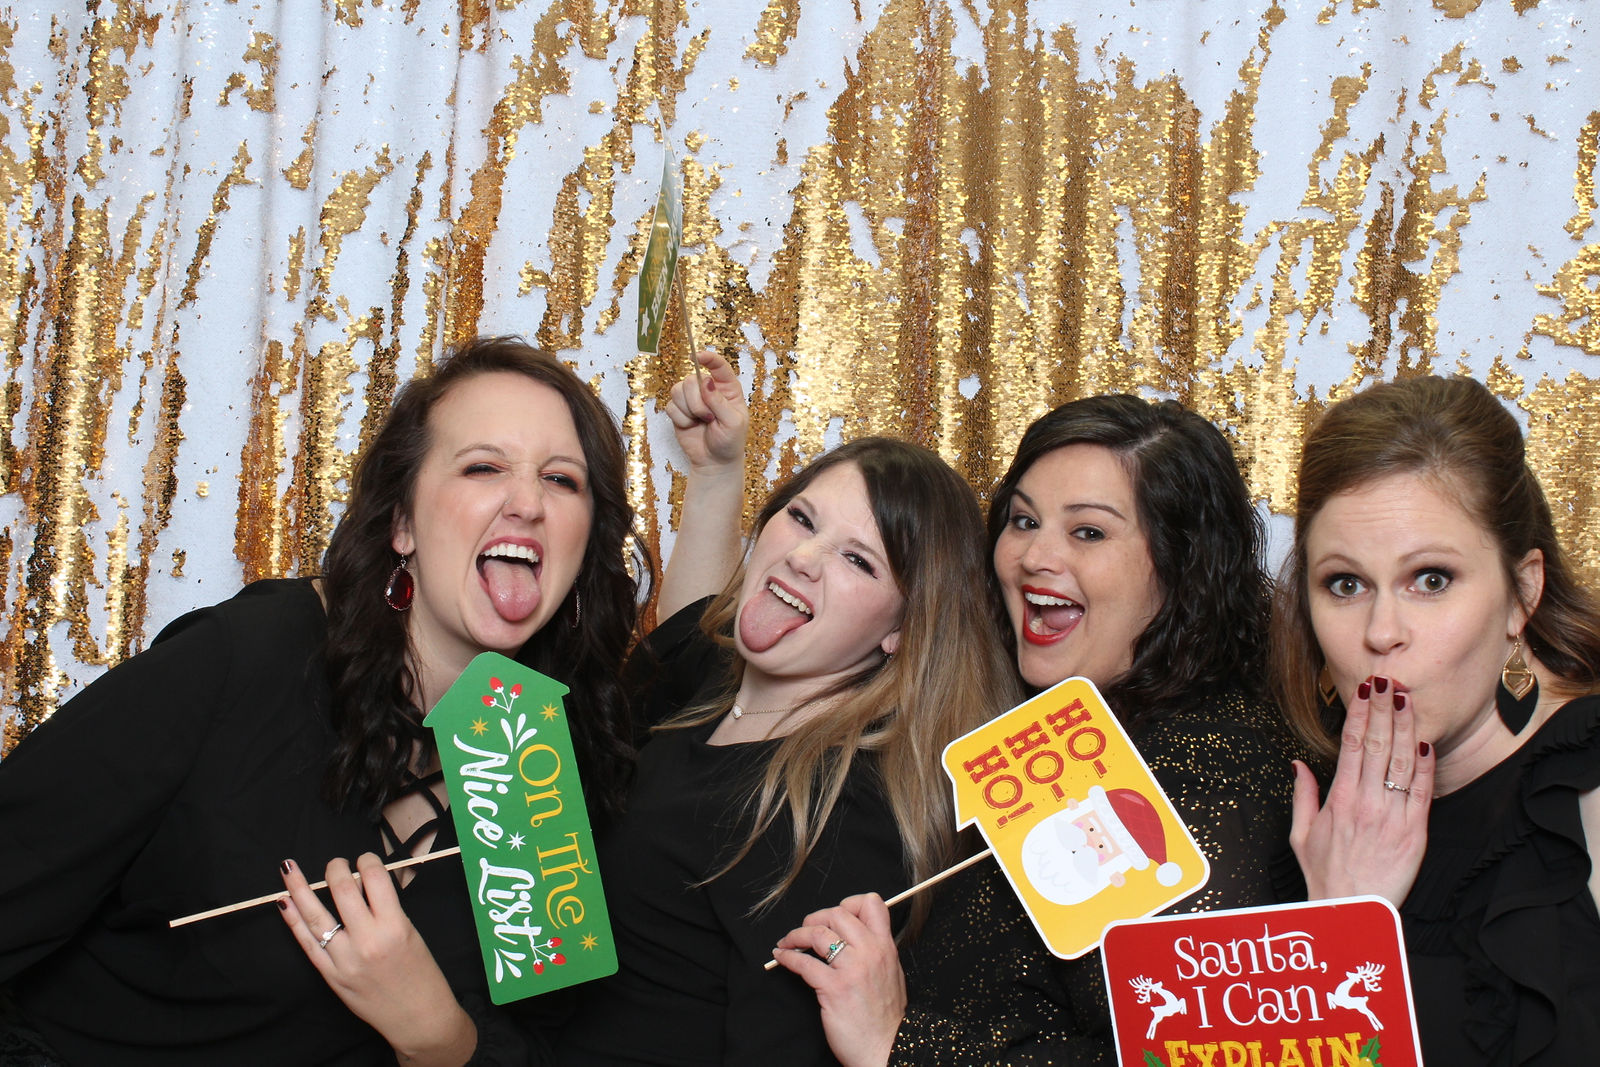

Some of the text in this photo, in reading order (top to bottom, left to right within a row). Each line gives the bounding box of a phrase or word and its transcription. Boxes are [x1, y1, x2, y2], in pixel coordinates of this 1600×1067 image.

[962, 745, 1034, 829] HO!
[453, 734, 542, 945] Nice List
[517, 743, 593, 930] On The
[1173, 923, 1328, 981] Santa,
[1192, 980, 1324, 1028] I Can
[1164, 1032, 1362, 1067] EXPLAIN
